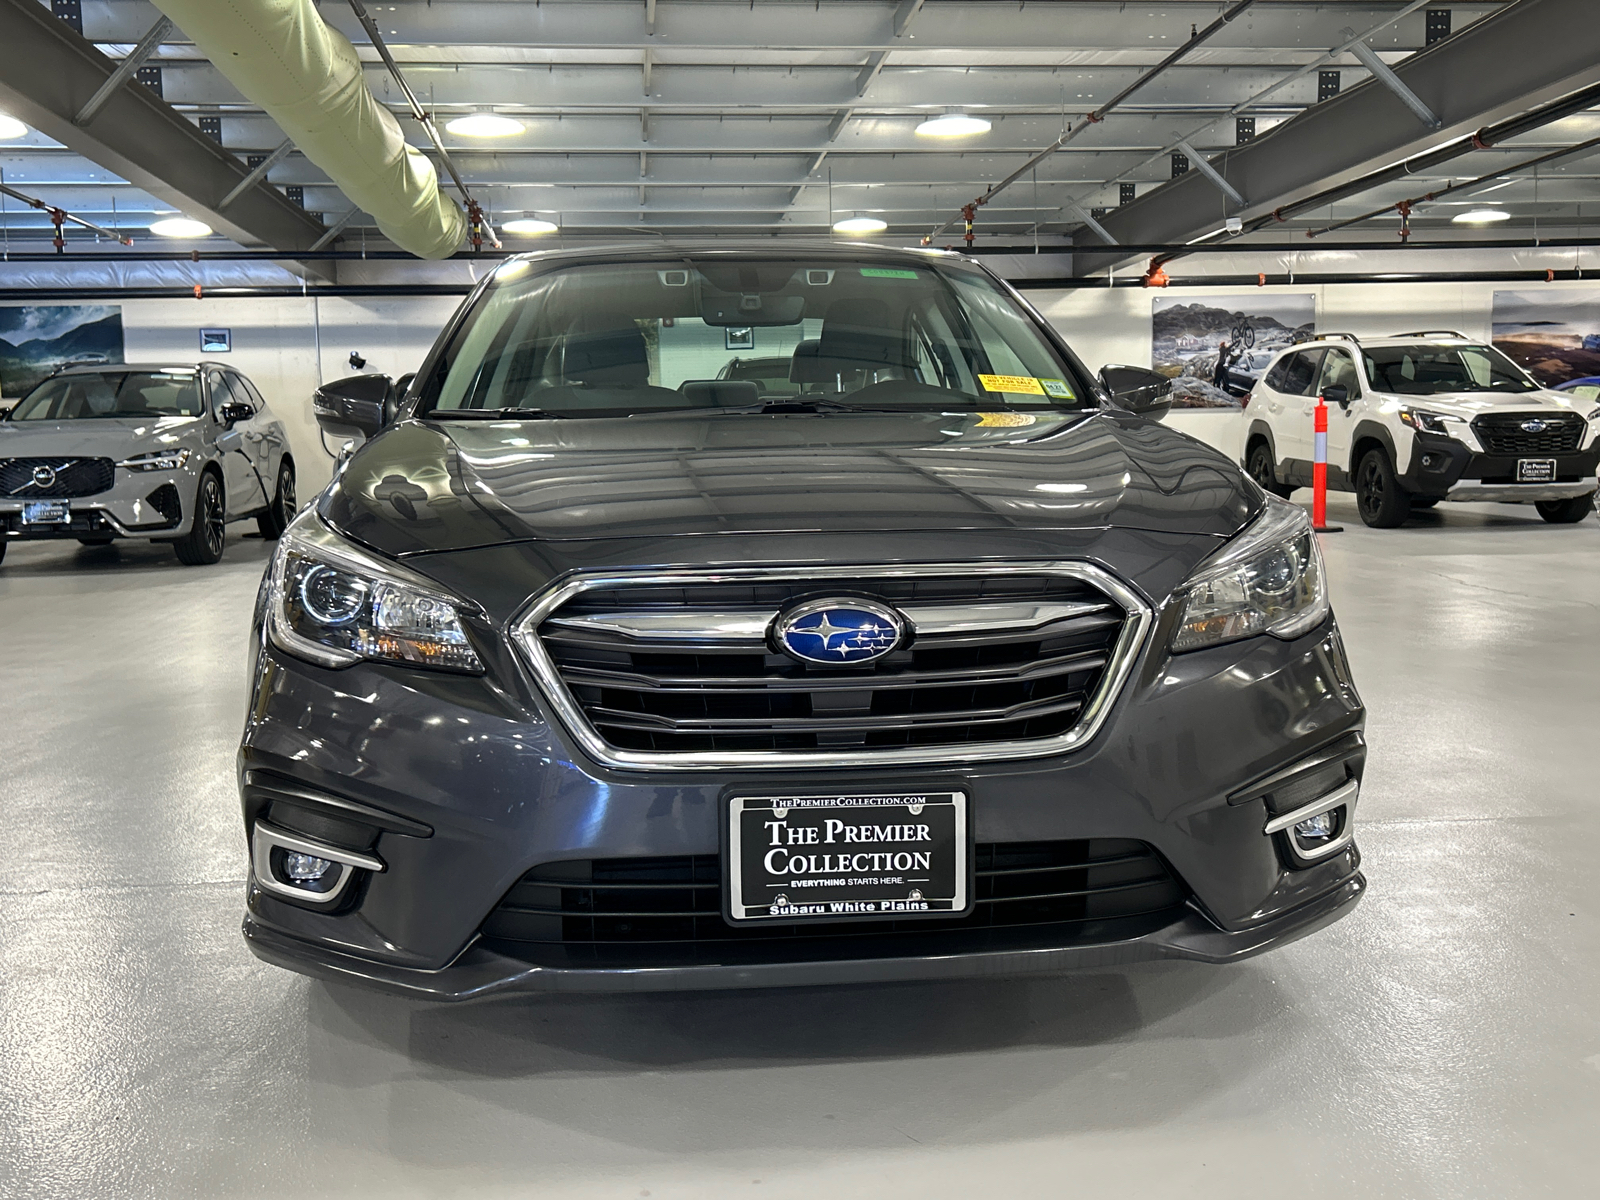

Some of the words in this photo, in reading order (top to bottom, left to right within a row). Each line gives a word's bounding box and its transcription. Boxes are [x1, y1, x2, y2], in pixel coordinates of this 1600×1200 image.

[764, 820, 819, 846] THE
[824, 819, 931, 844] PREMIER
[764, 848, 931, 875] COLLECTION
[791, 878, 846, 888] EVERYTHING
[847, 877, 879, 886] STARTS
[879, 876, 905, 885] HERE.
[769, 904, 825, 915] Subaru
[830, 902, 875, 913] White
[881, 900, 929, 911] Plains
